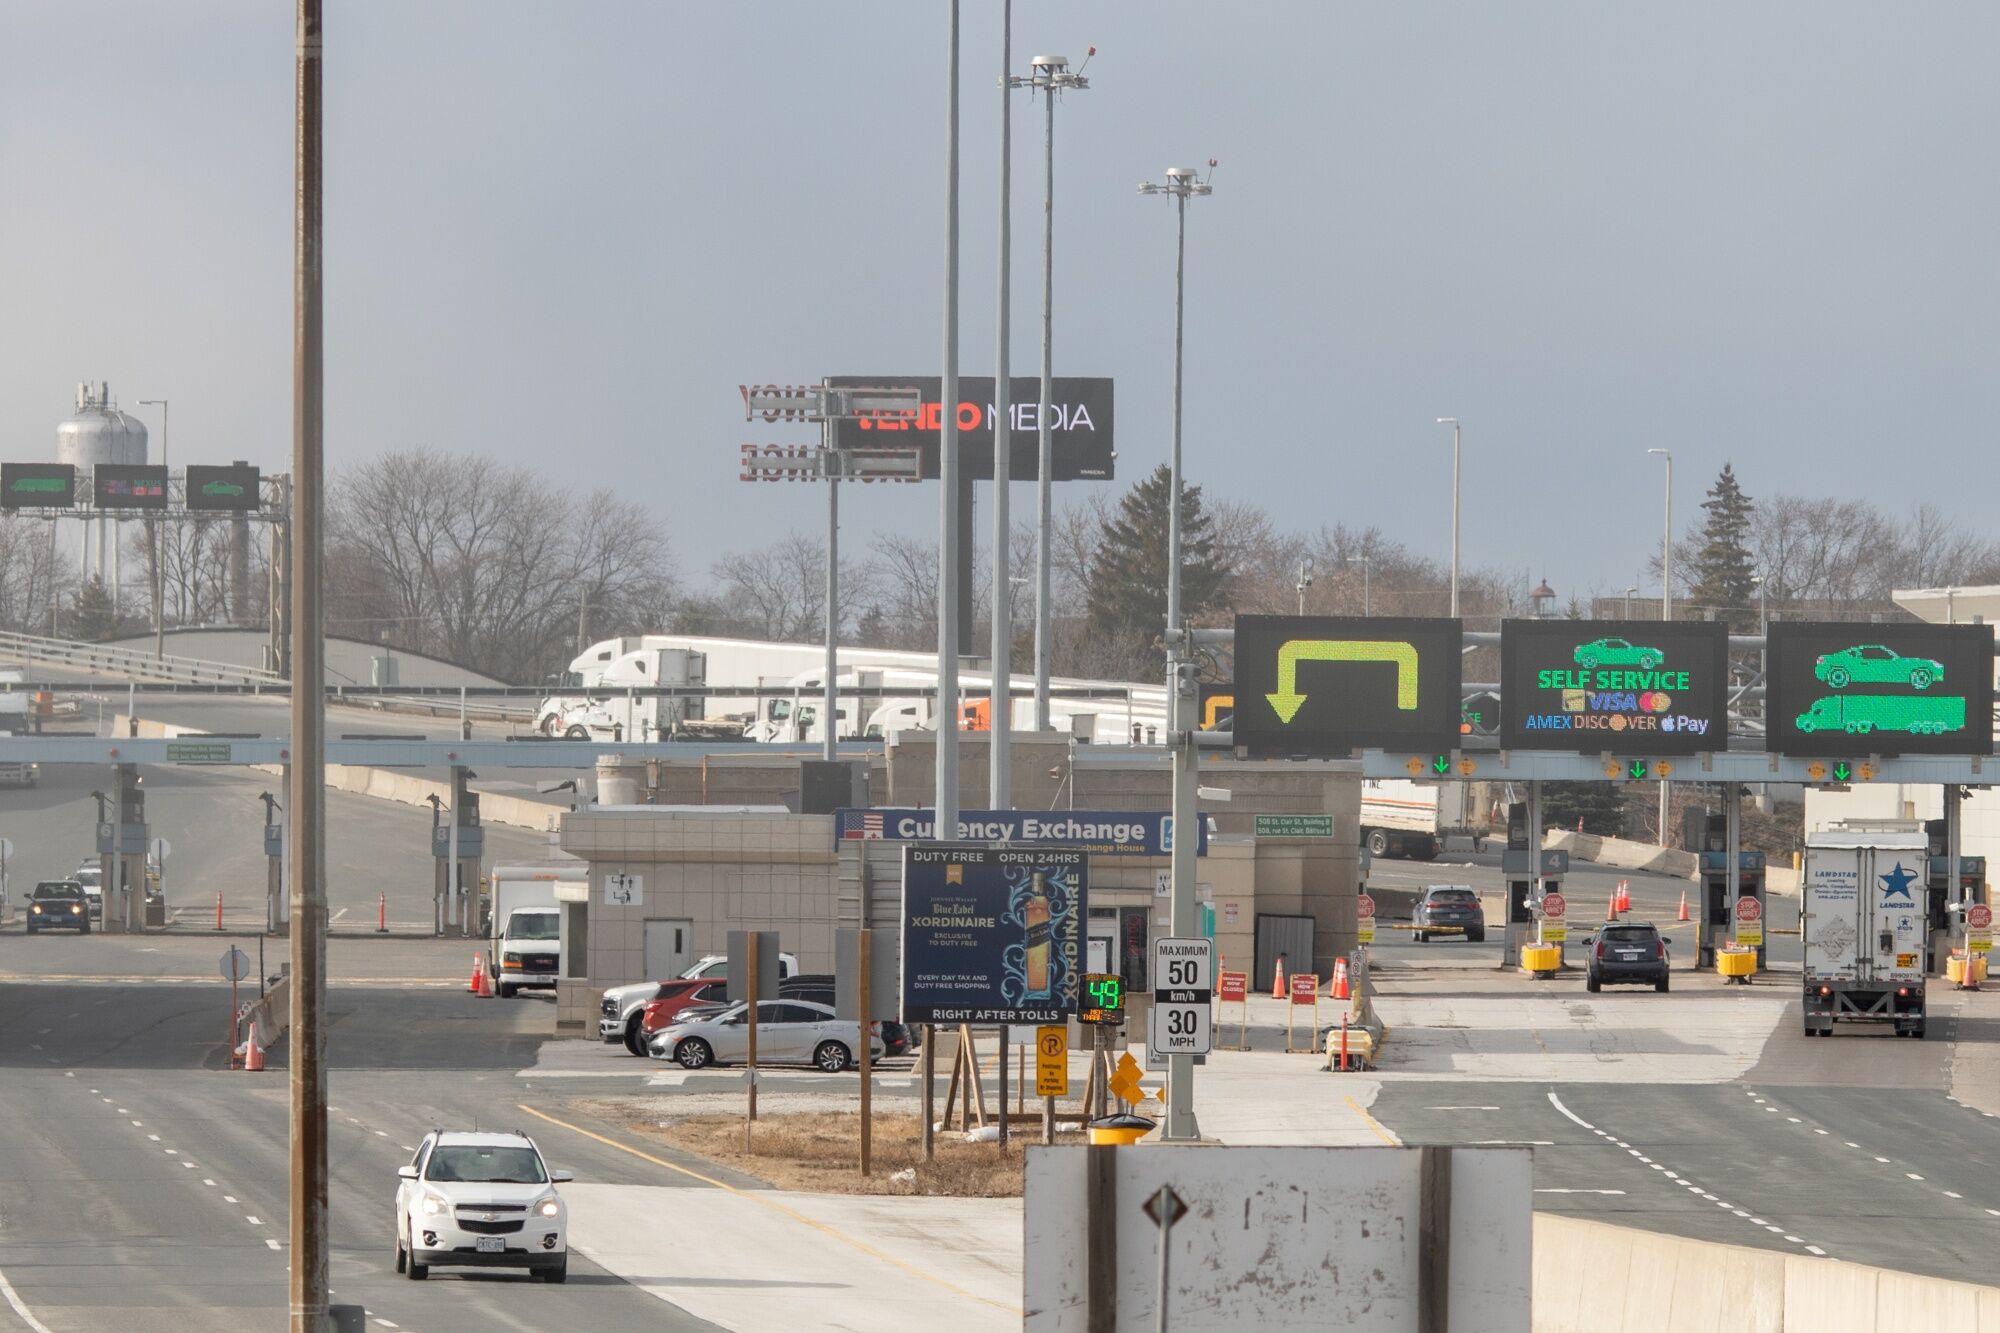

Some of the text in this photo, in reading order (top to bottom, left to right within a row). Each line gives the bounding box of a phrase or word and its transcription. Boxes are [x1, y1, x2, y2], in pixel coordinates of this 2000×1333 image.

[1537, 669, 1690, 690] SELF SERVICE
[1588, 691, 1637, 711] VISA
[1525, 714, 1709, 734] AMEX DISCOVER Pay
[101, 825, 111, 838] 6
[270, 827, 280, 838] 7
[437, 828, 447, 840] 8
[898, 817, 1145, 842] Cuency Exchange
[1116, 844, 1145, 852] House
[914, 852, 1080, 863] DUTY FREE OPEN 24HRS
[1548, 854, 1560, 867] 4
[1746, 857, 1756, 868] 3
[1967, 861, 1977, 872] 2
[1547, 897, 1561, 905] STOP
[1740, 901, 1756, 909] STOP
[932, 903, 974, 915] Blue Label
[912, 917, 995, 928] XORDINAIRE
[1064, 873, 1079, 1000] XORDINAIRE
[1160, 946, 1208, 956] MAXIMUM
[1169, 960, 1198, 985] 50
[954, 982, 991, 990] SHOPPING
[1089, 980, 1119, 1009] 49
[1170, 990, 1195, 1001] km/h
[932, 1009, 1059, 1020] RIGHT AFTER TOLLS
[1168, 1010, 1197, 1035] 30
[1169, 1037, 1195, 1047] MPH
